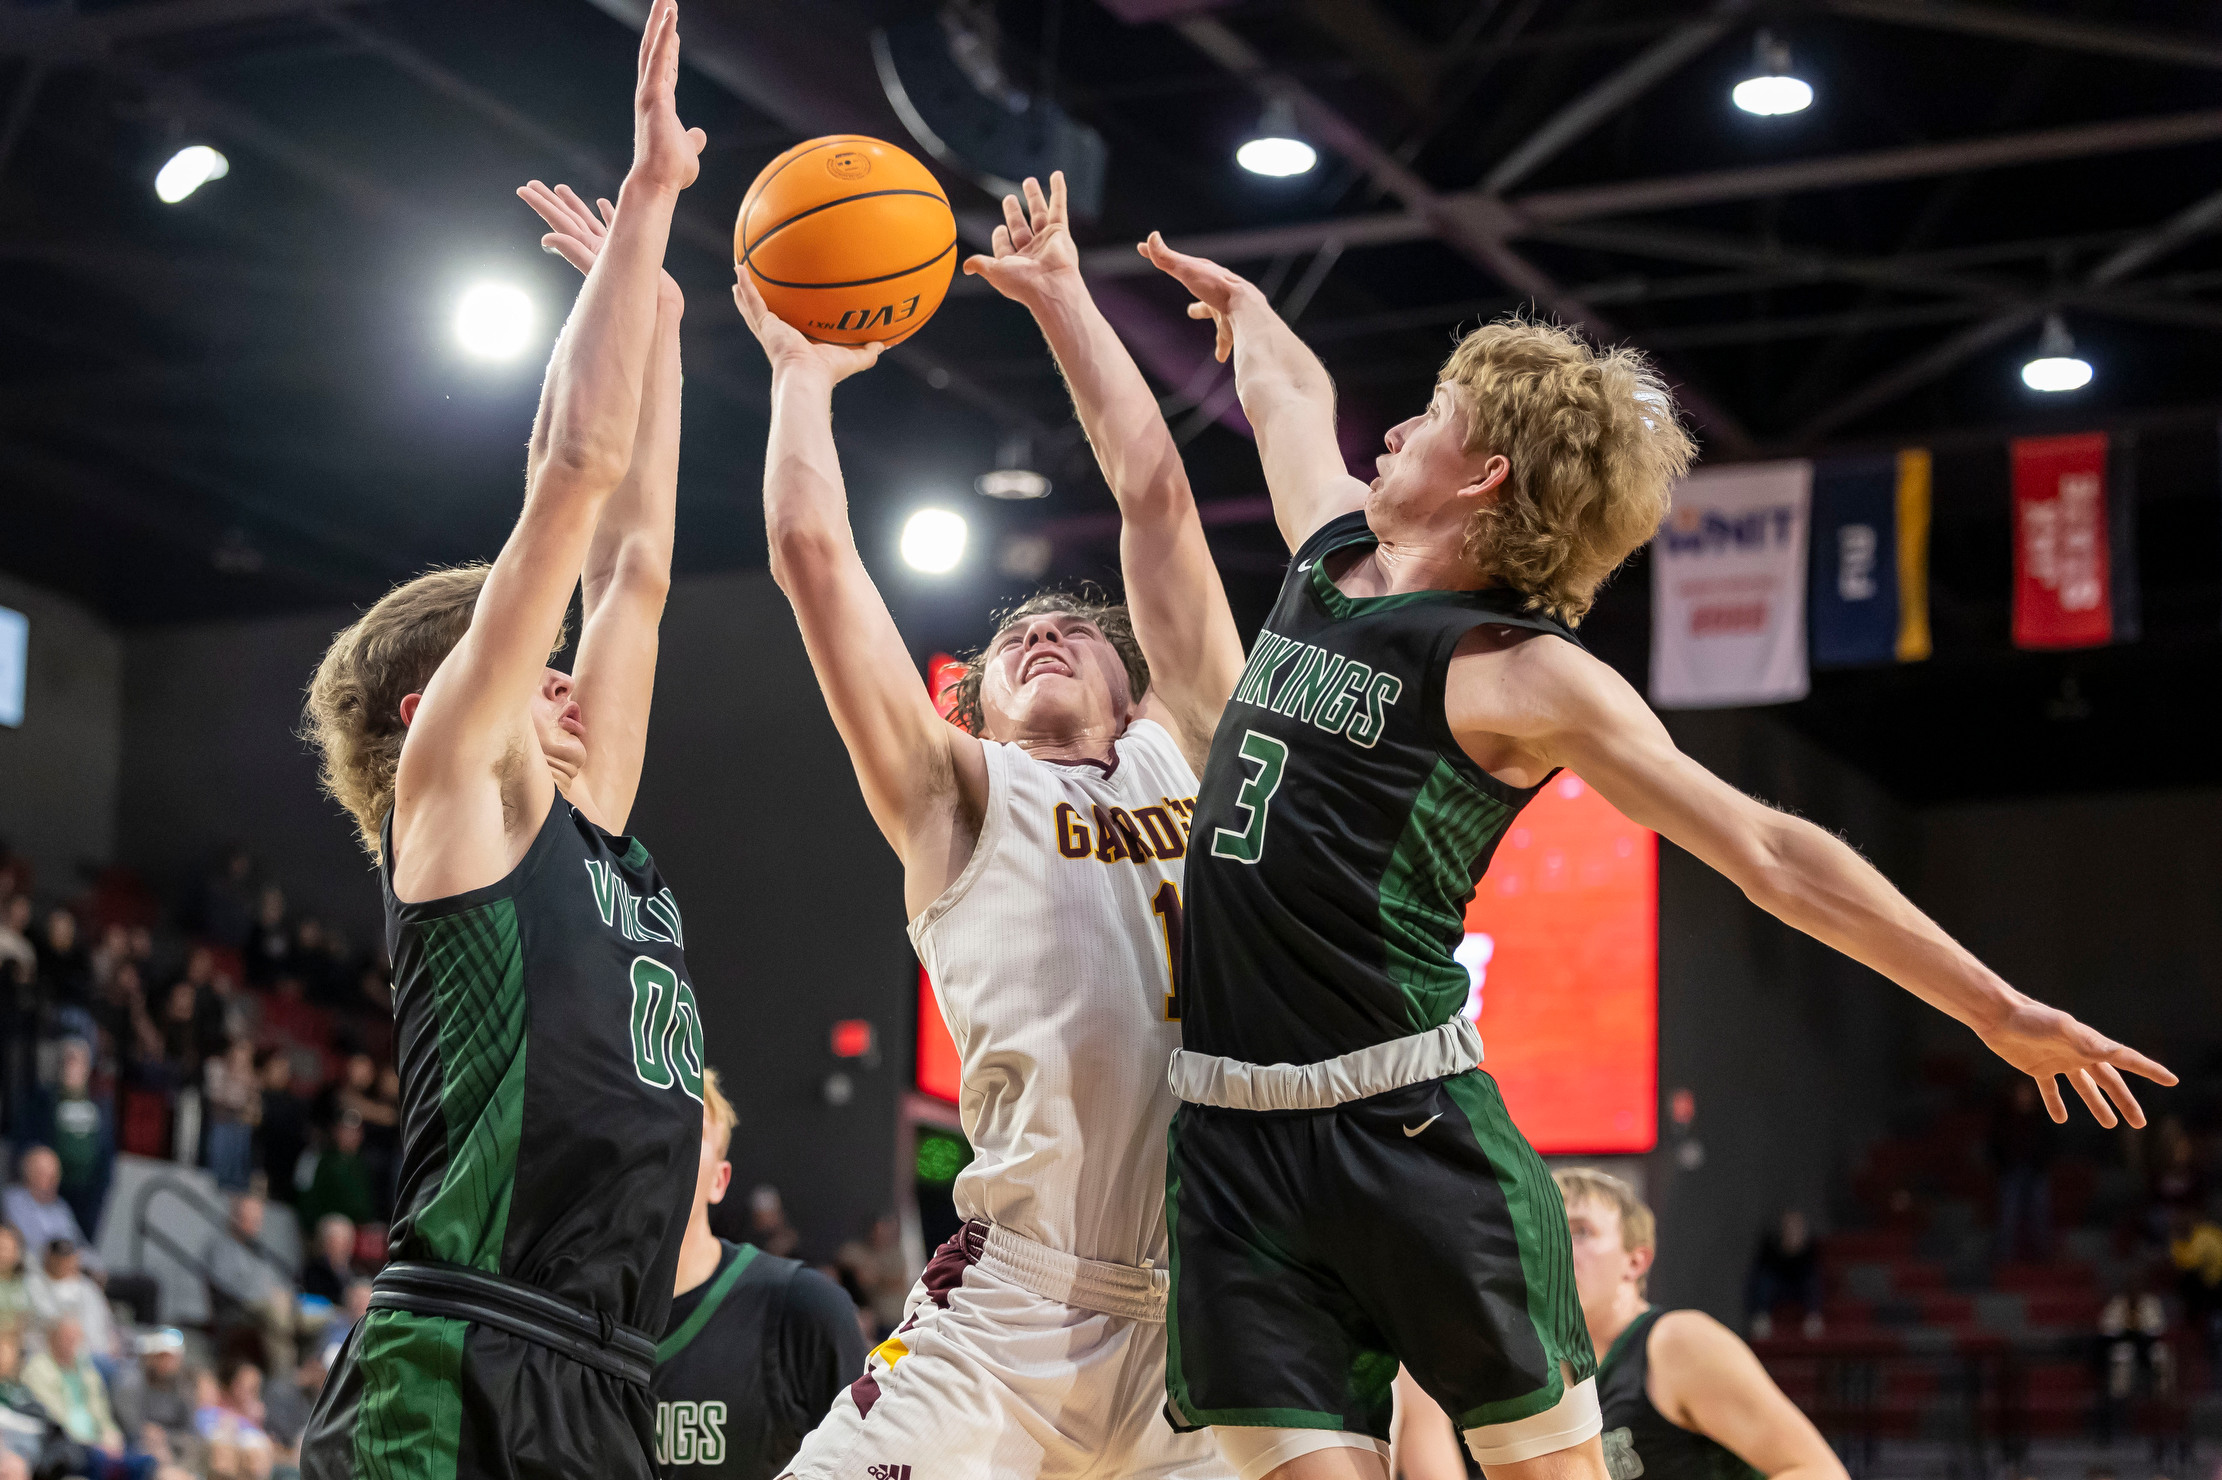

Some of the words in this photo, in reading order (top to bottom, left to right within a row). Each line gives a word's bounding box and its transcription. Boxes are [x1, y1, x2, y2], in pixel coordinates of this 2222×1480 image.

[836, 294, 920, 331] EVO
[1053, 795, 1197, 865] GARD
[1211, 729, 1288, 864] 3
[630, 955, 704, 1105] 00
